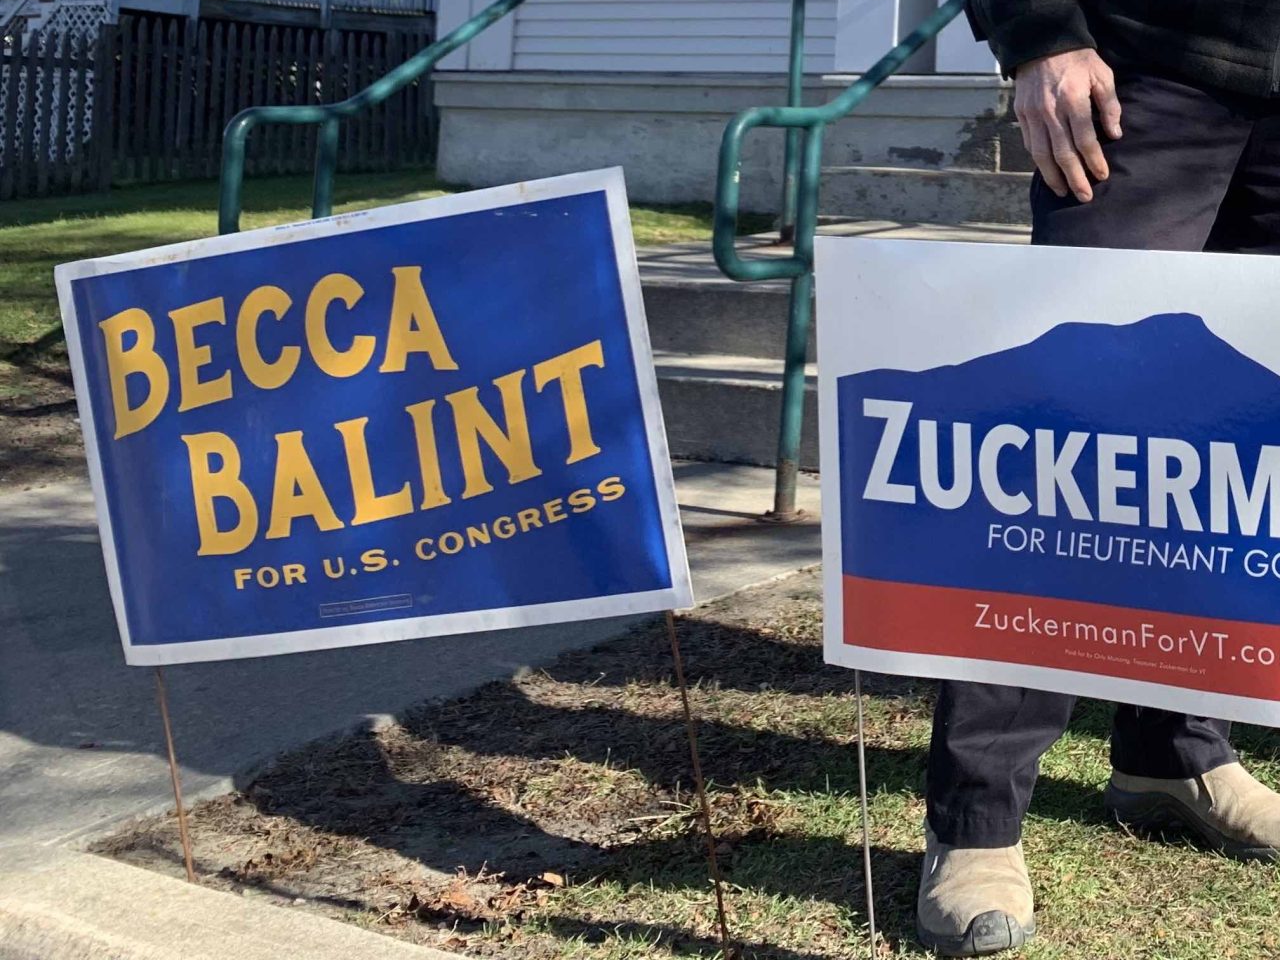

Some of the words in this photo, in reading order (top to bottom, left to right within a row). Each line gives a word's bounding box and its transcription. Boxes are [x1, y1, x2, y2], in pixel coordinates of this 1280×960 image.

[99, 265, 458, 440] BECCA
[181, 340, 604, 556] BALINT
[235, 563, 306, 589] FOR
[323, 548, 400, 579] U.S.
[415, 477, 626, 559] CONGRESS
[987, 524, 1045, 554] FOR
[1056, 530, 1234, 574] LIEUTENANT
